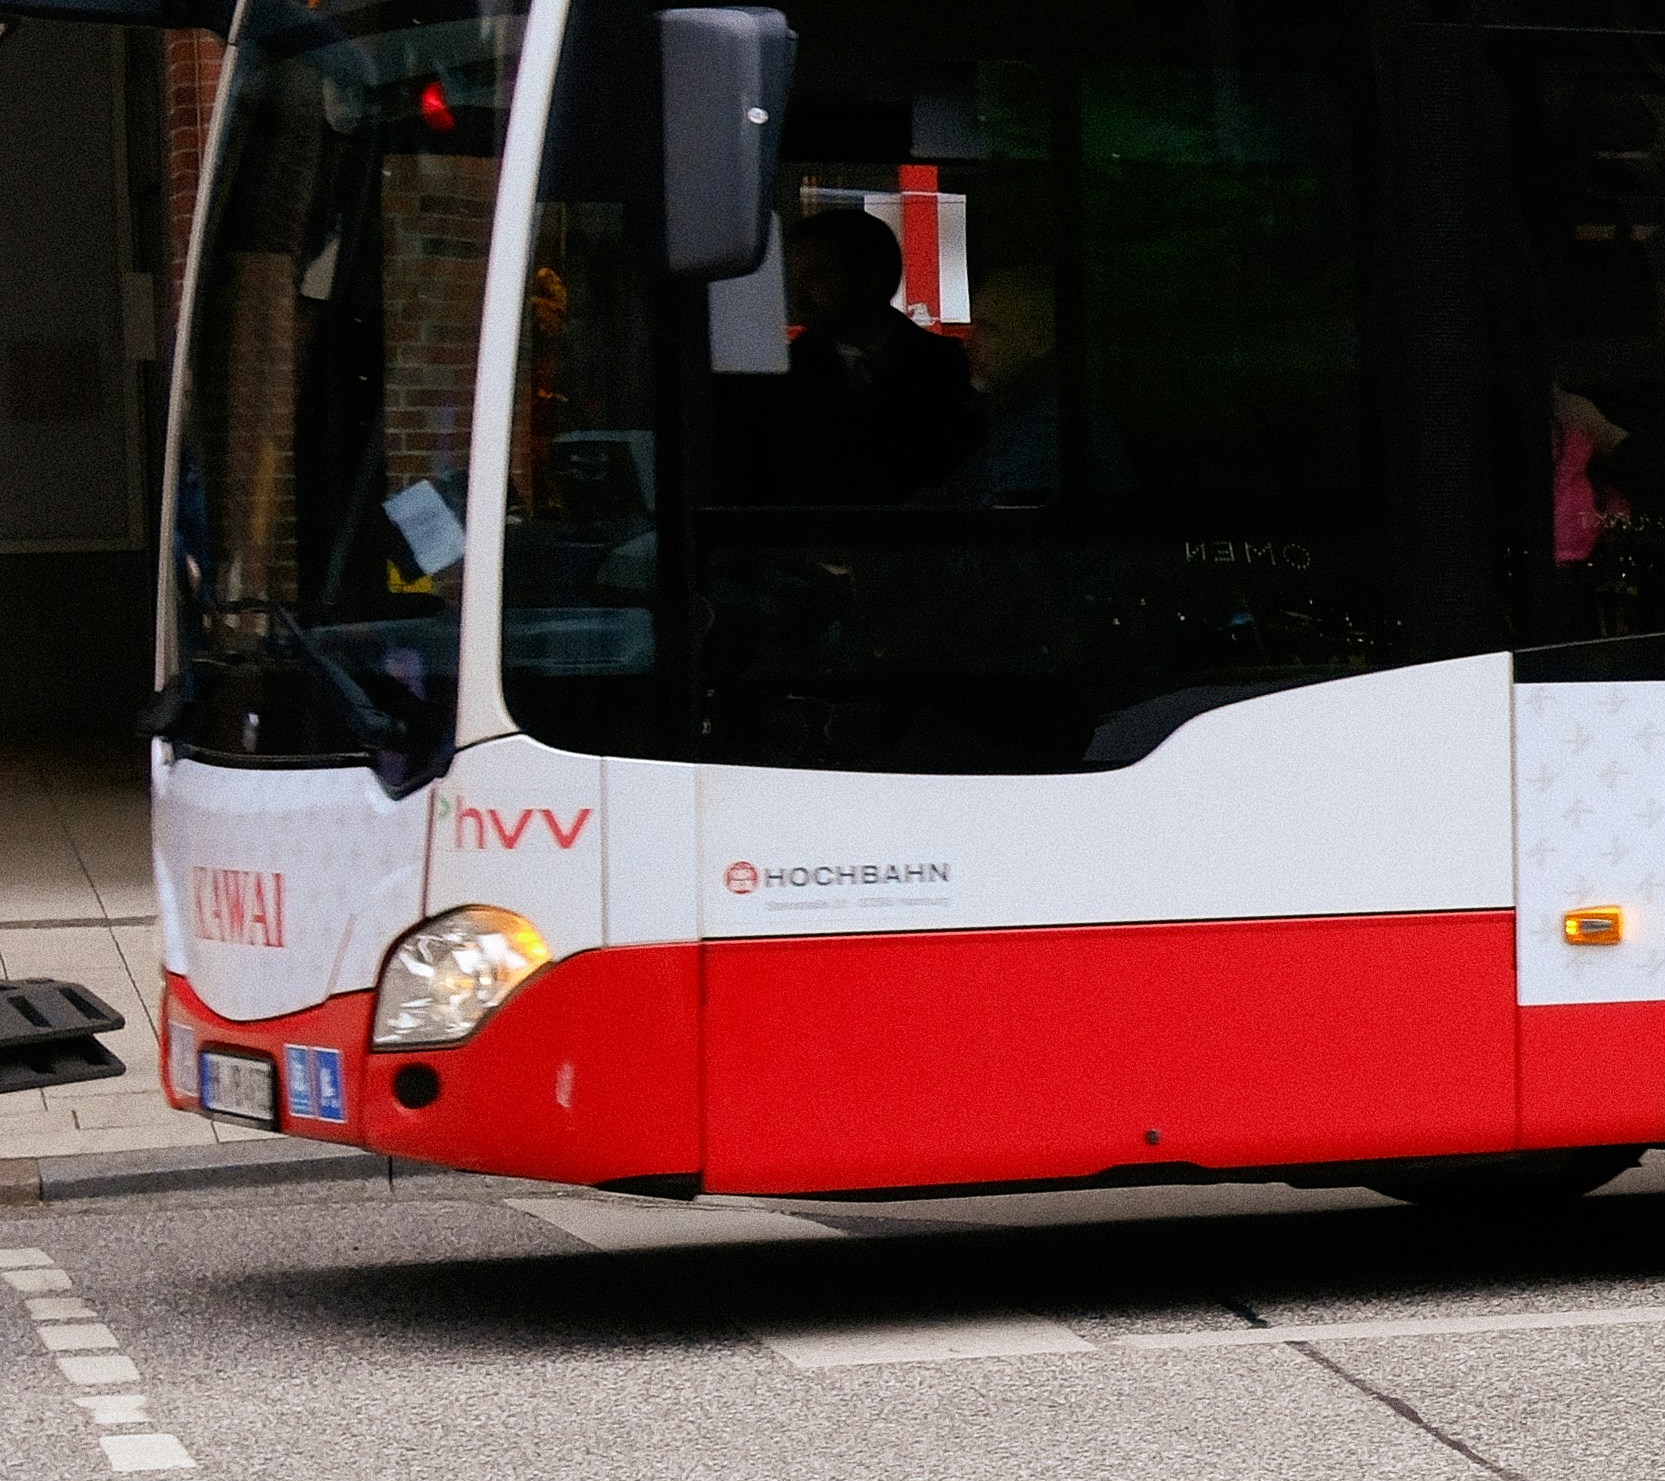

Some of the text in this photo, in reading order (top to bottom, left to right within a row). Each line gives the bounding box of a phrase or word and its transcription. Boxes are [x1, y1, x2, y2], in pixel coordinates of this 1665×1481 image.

[453, 795, 594, 851] hvv
[763, 862, 950, 888] HOCHBAHN
[193, 865, 286, 948] KAWAI
